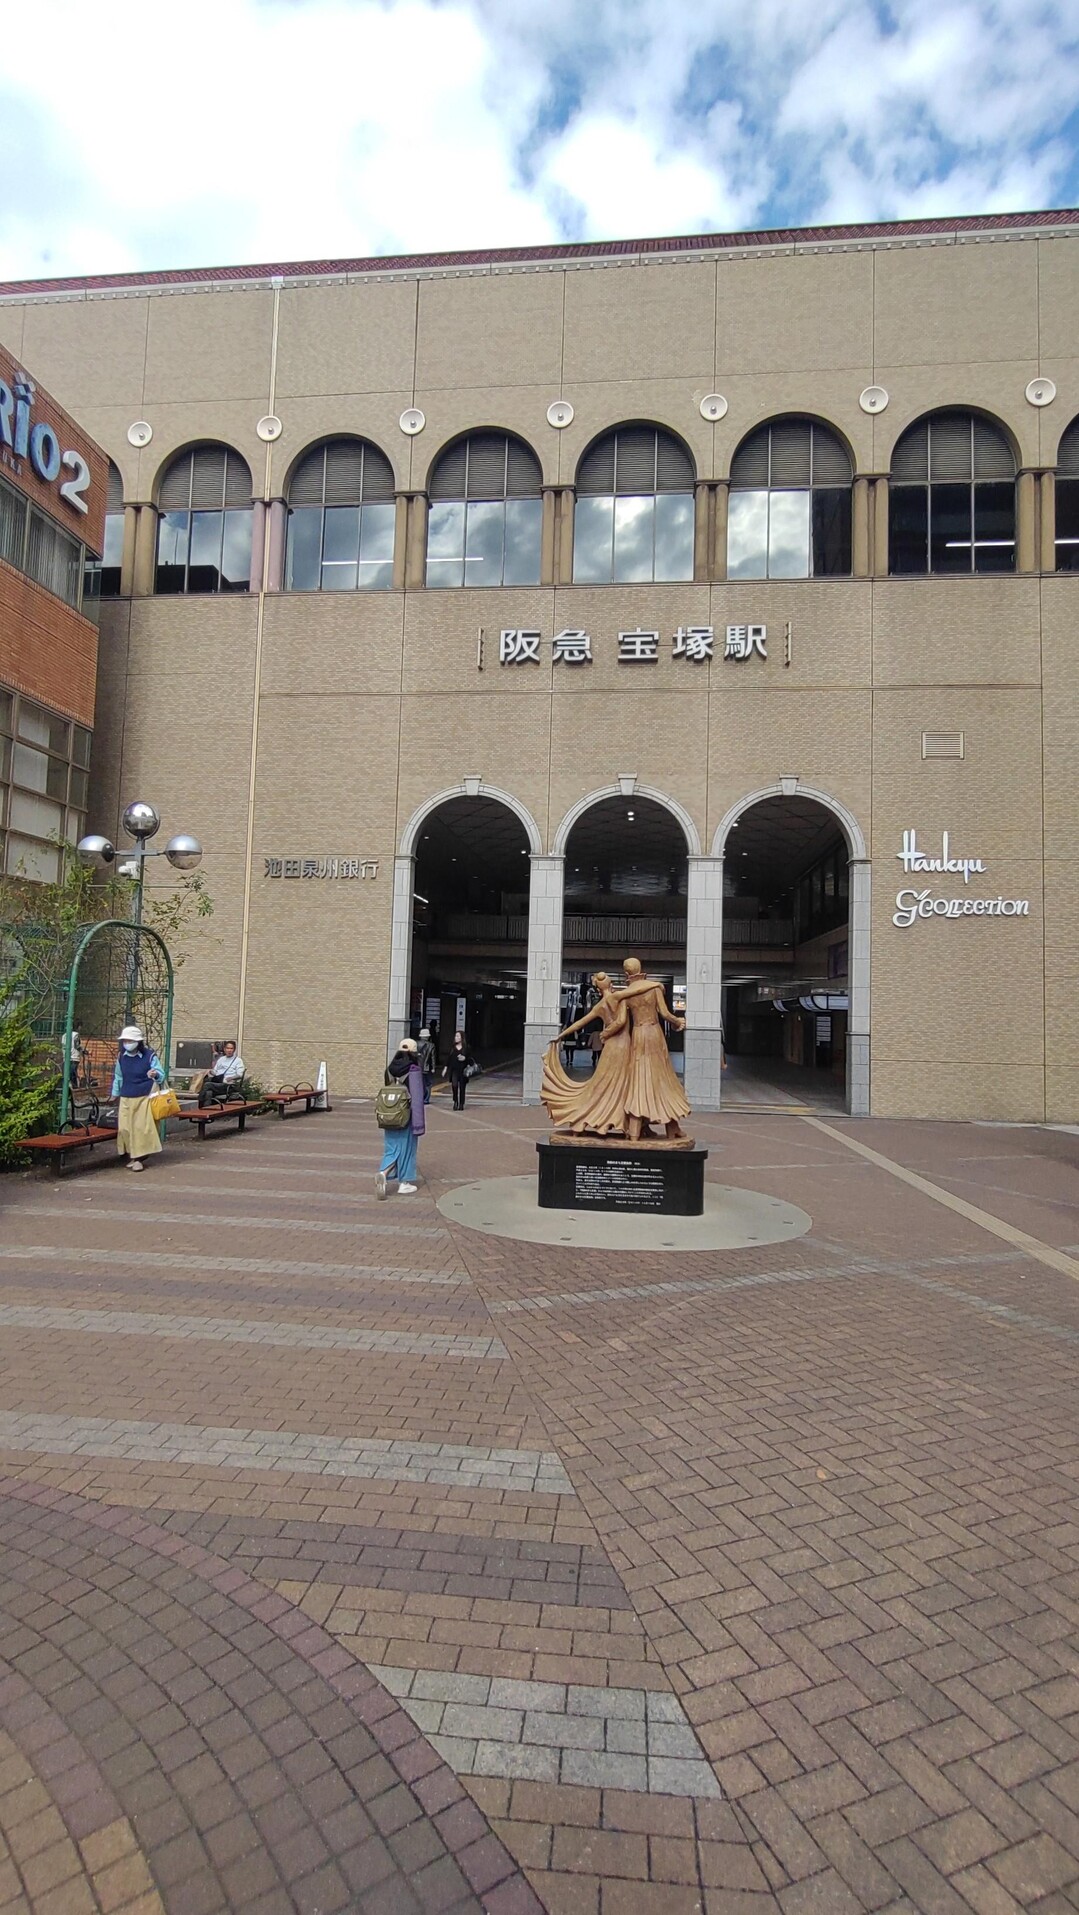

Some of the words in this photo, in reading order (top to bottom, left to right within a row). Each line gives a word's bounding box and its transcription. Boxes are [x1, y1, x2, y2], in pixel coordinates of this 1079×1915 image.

[499, 628, 594, 666] 阪急
[617, 624, 768, 664] 宝塚駅
[264, 857, 379, 880] 池田泉州銀行
[896, 828, 987, 885] Hankyu
